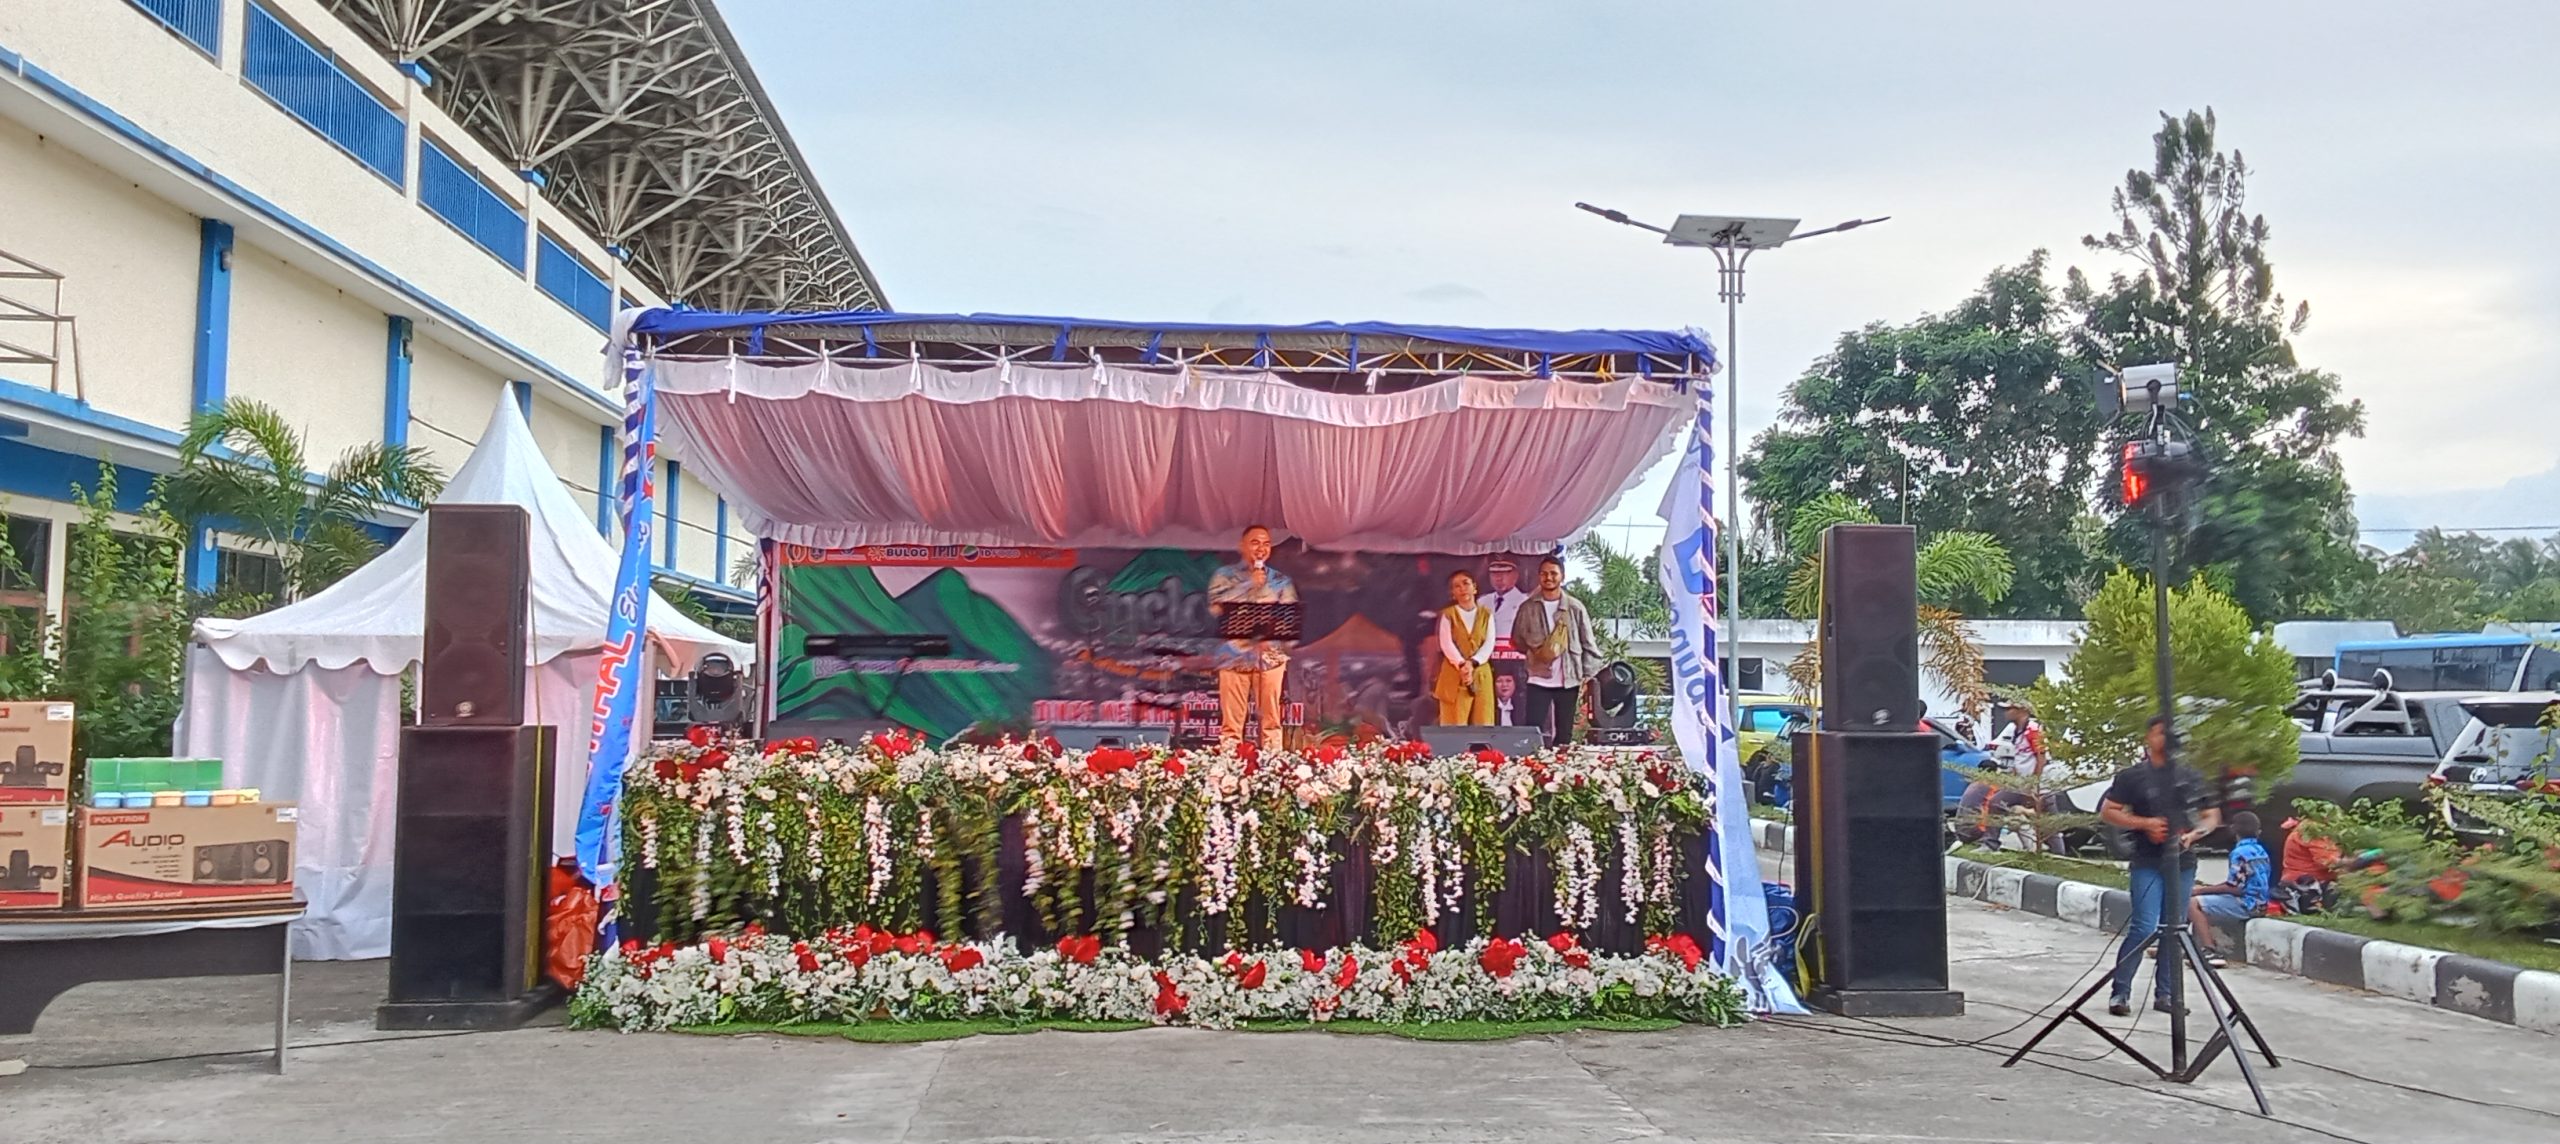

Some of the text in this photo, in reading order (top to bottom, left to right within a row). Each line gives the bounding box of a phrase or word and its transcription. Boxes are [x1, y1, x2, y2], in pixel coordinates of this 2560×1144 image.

[887, 547, 928, 557] BULOG
[93, 815, 147, 824] POLYTRON
[90, 889, 183, 903] High Quality Sound
